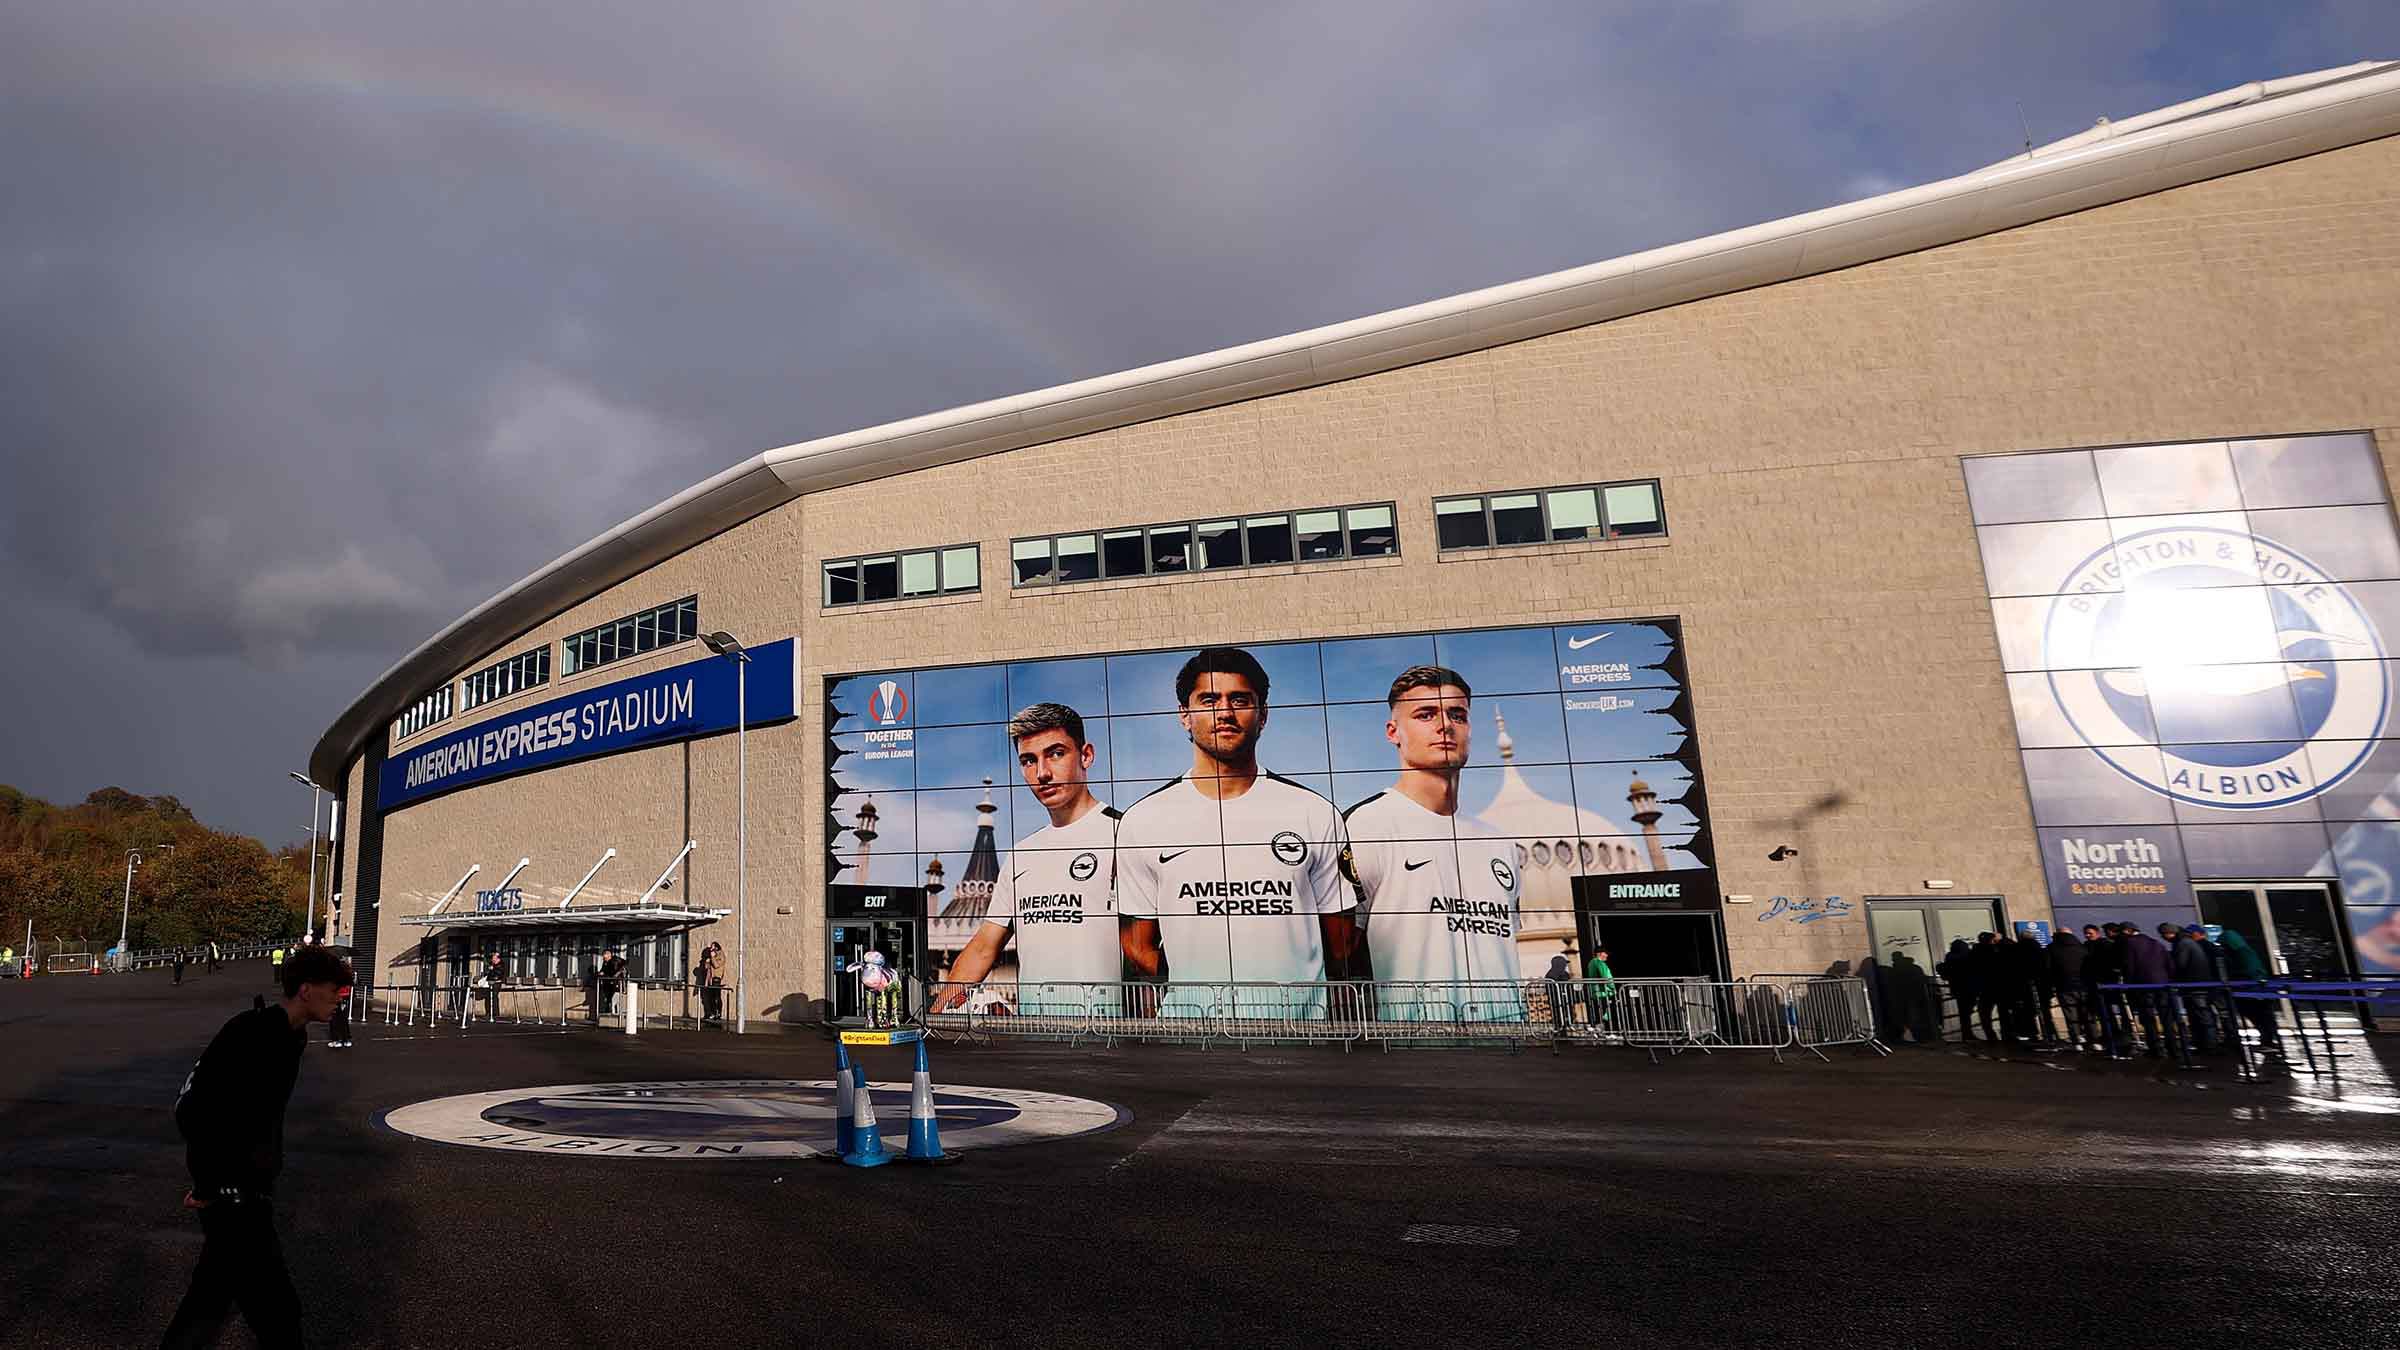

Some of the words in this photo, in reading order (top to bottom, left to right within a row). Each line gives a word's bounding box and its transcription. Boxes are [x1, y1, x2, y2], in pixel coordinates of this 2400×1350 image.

[2069, 539, 2197, 615] BRIGHTON
[2215, 542, 2236, 560] &
[2255, 551, 2329, 604] HOVE
[1560, 664, 1629, 675] AMERICAN
[1572, 672, 1632, 684] EXPRESS
[405, 736, 480, 790] AMERICAN
[481, 707, 578, 766] EXPRESS
[581, 679, 694, 740] STADIUM
[865, 730, 913, 743] TOGETHER
[2172, 766, 2302, 796] ALBION
[2062, 838, 2160, 863] North
[2066, 864, 2165, 881] Reception
[1178, 880, 1292, 898] AMERICAN
[1609, 884, 1680, 898] ENTRANCE
[2071, 883, 2083, 894] &
[2087, 883, 2115, 894] Club
[2118, 882, 2167, 894] Offices
[476, 888, 522, 911] TICKETS
[864, 896, 887, 907] EXIT
[1196, 899, 1294, 915] EXPRESS
[1430, 896, 1509, 920] AMERICAN
[1024, 910, 1083, 924] EXPRESS
[458, 1133, 743, 1154] ALBION
